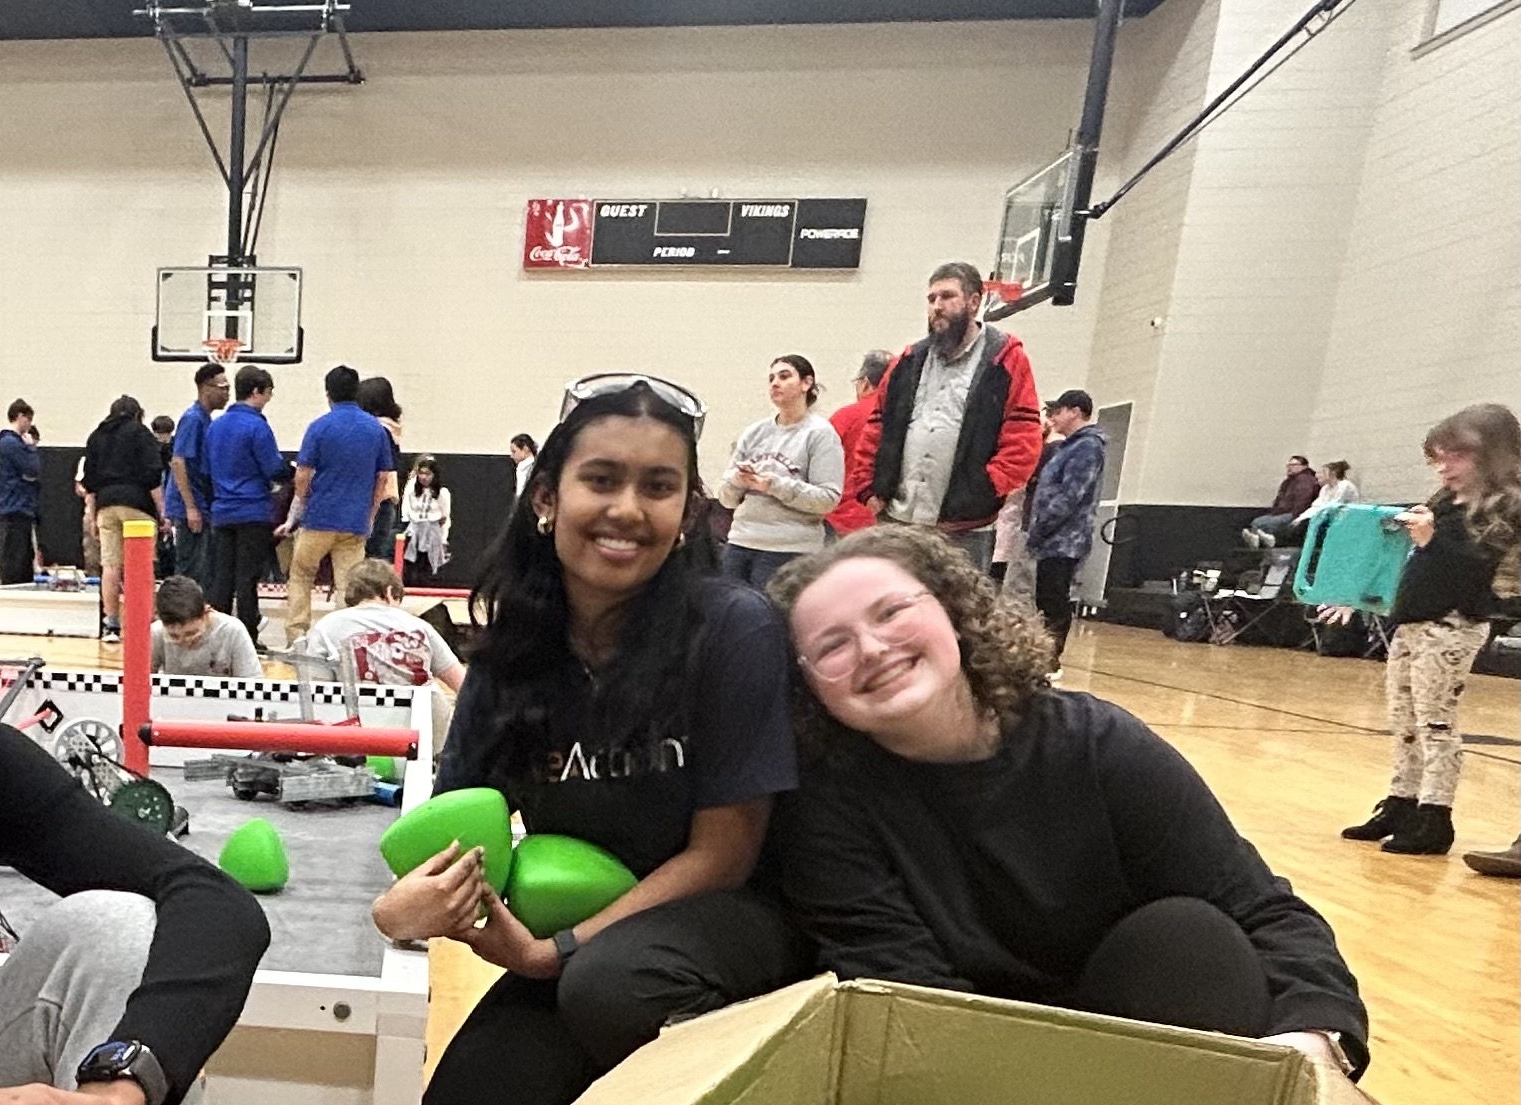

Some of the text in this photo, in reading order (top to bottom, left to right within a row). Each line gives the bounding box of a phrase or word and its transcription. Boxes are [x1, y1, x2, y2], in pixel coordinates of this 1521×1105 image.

[599, 204, 649, 218] GUEST
[740, 204, 791, 218] VIKINGS
[799, 228, 860, 240] POWERADE
[652, 246, 696, 258] PERIOD
